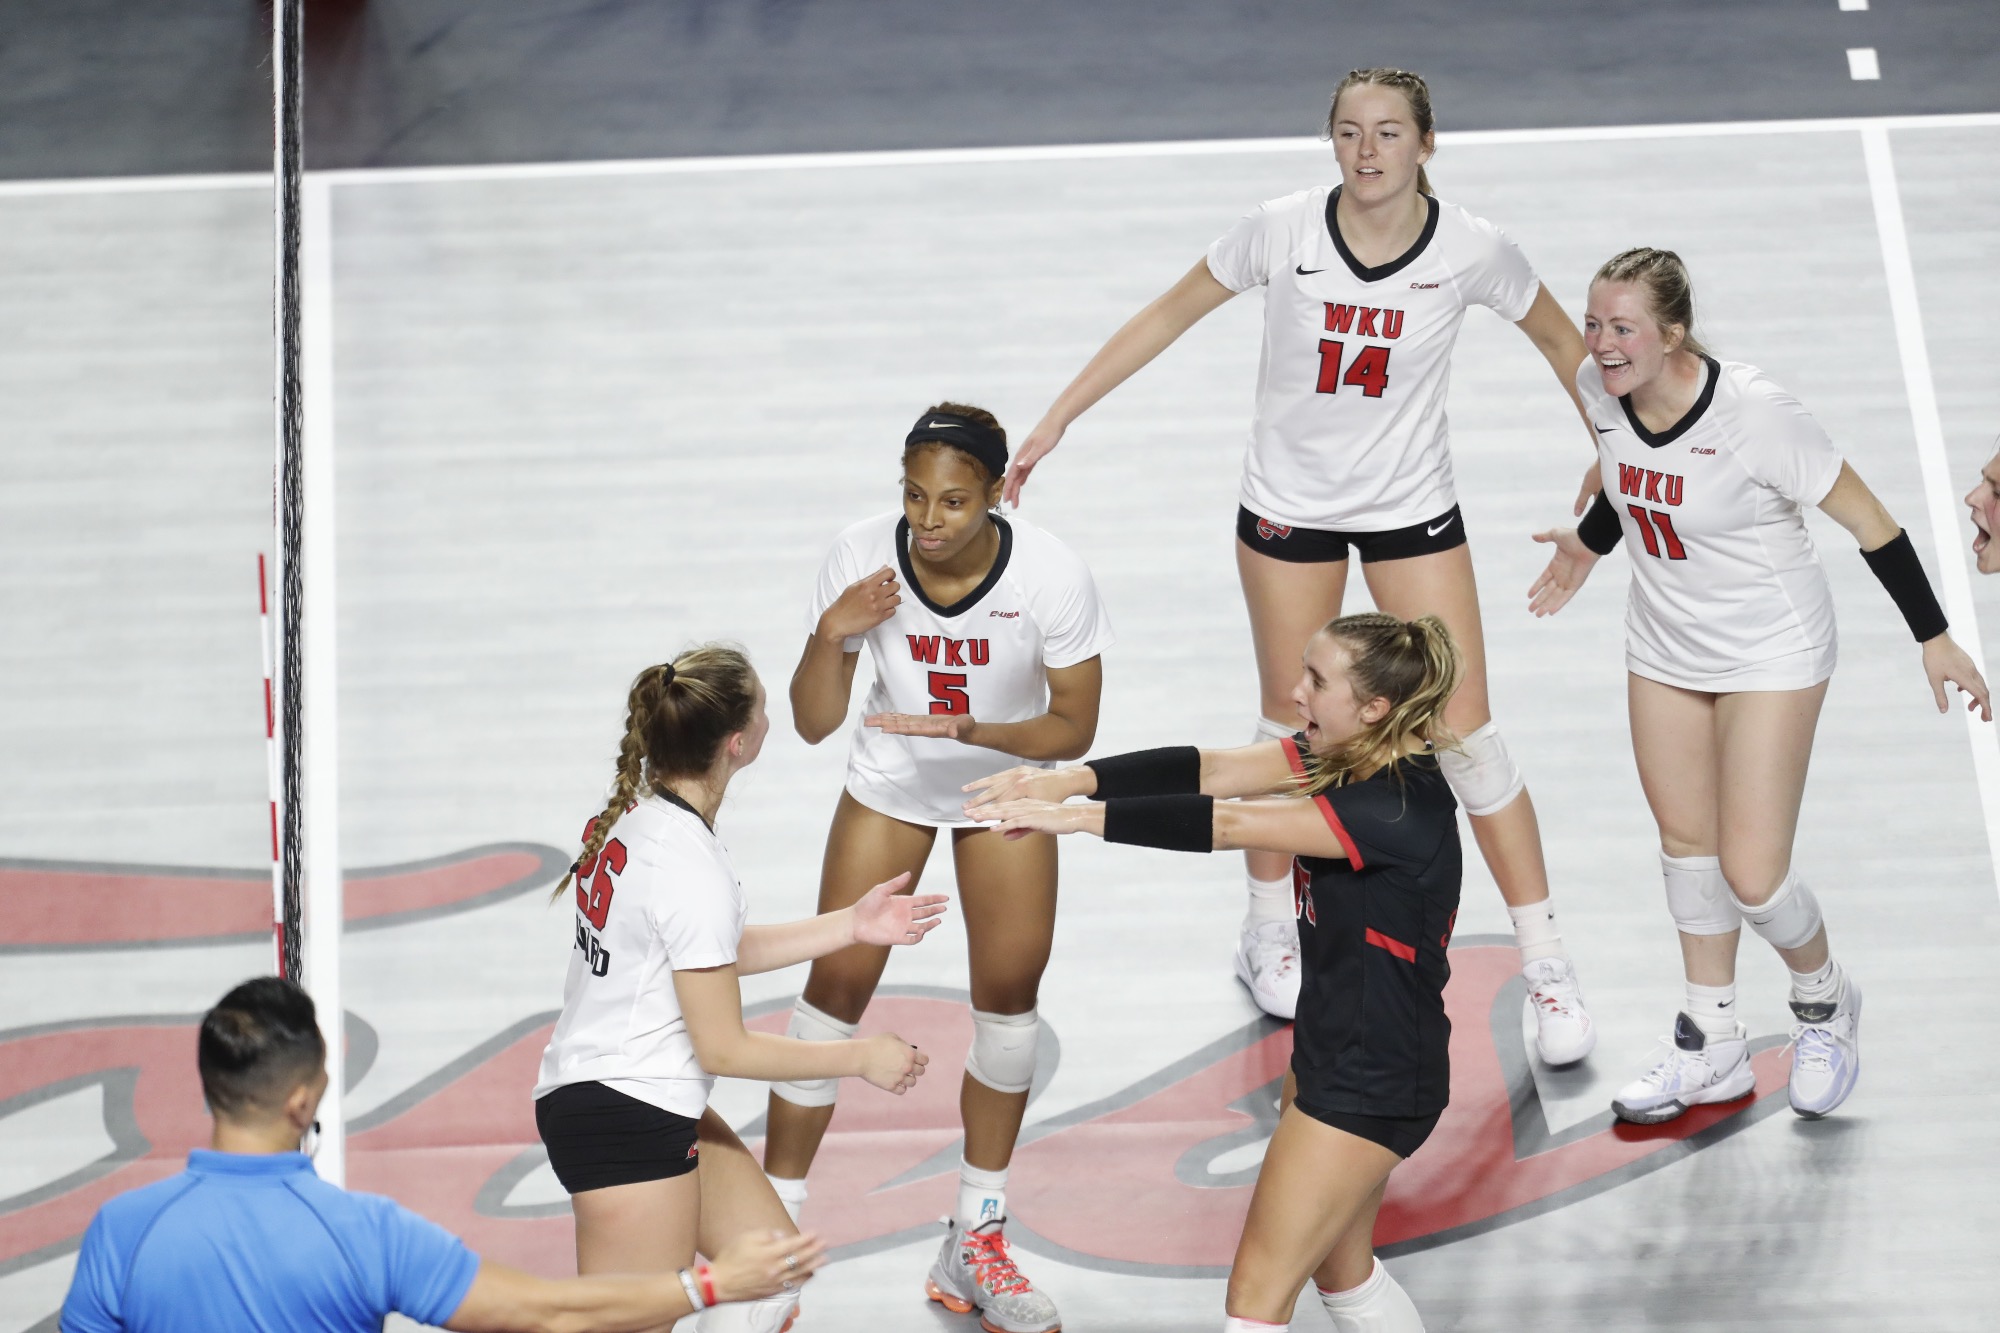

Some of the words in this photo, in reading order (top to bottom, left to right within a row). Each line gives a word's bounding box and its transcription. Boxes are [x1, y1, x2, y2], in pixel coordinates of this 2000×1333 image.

[1323, 301, 1404, 340] WKU
[1316, 338, 1390, 398] 14
[1618, 462, 1684, 506] WKU
[1626, 503, 1688, 560] 11
[905, 634, 990, 667] WKU
[927, 670, 970, 716] 5
[575, 815, 627, 932] 26
